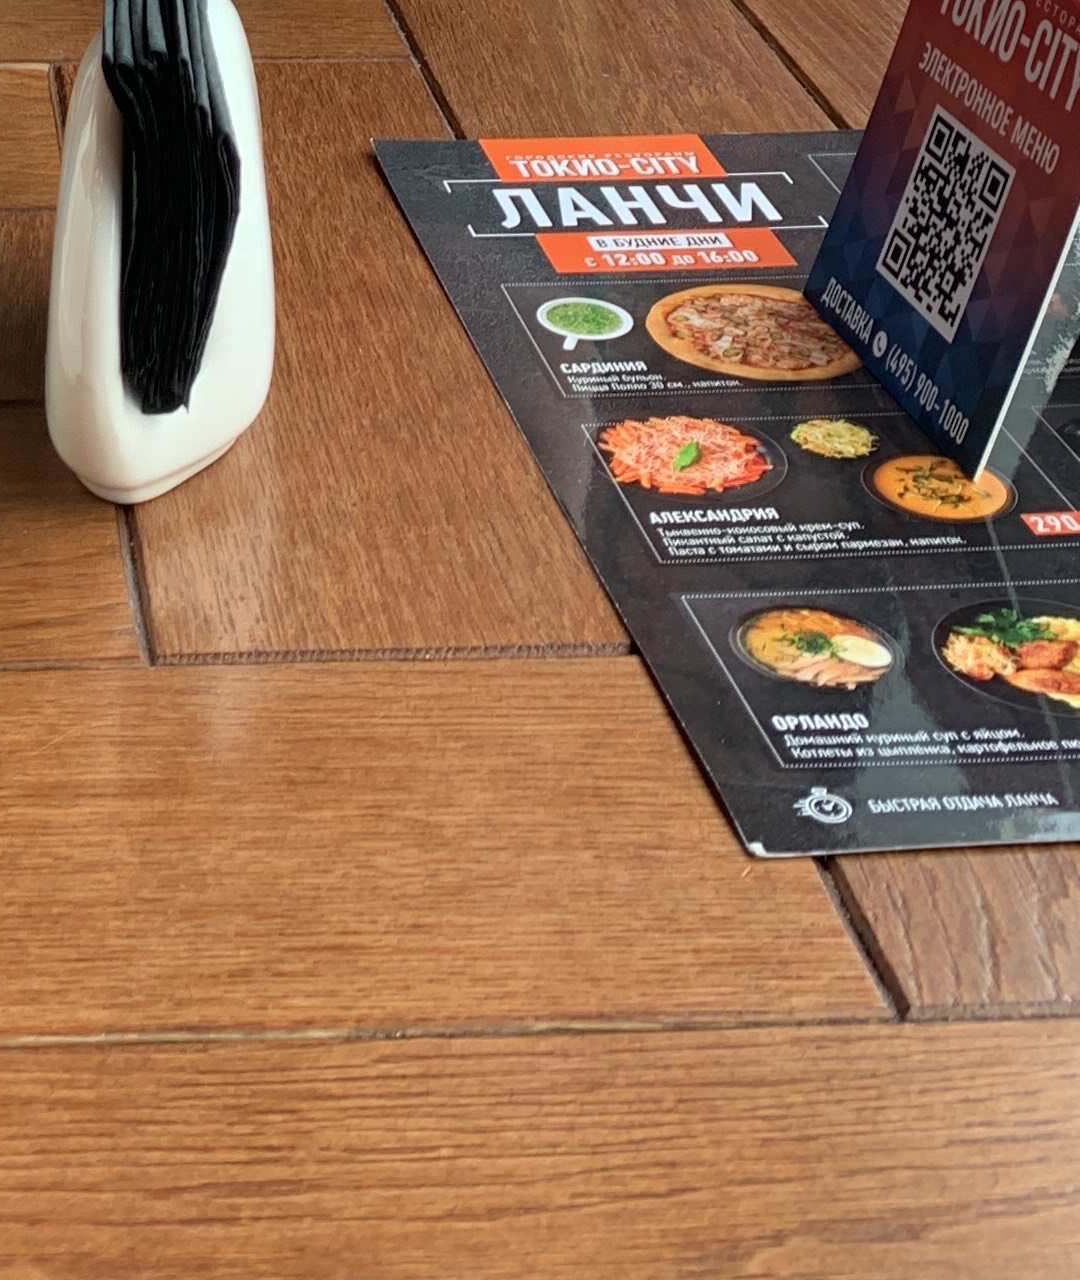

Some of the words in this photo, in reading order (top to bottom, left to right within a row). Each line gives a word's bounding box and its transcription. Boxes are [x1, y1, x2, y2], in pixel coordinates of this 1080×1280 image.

[918, 41, 1014, 137] ЭЛЕКТРОННОЕ
[1010, 115, 1060, 174] МЕНЮ
[509, 155, 700, 178] ТОКИО-CITY
[492, 182, 783, 229] ЛАНЧИ
[596, 236, 608, 248] В
[615, 235, 678, 249] БУДНИЕ
[684, 234, 722, 248] ДНИ
[603, 251, 666, 266] 12:00
[672, 254, 695, 266] до
[697, 250, 759, 265] 16:00
[560, 361, 648, 375] САРДИНИЯ
[821, 277, 874, 345] ДОСТАВКА
[885, 343, 917, 392] (495)
[913, 372, 969, 445] 900-1000
[567, 375, 620, 385] Куриный
[572, 383, 610, 392] Пицца
[648, 381, 665, 390] 30
[649, 507, 780, 524] АЛЕКСАНДРИЯ
[657, 523, 797, 538] Тыквенно-кокосовый
[663, 534, 736, 547] Пикантный
[738, 534, 773, 544] салат
[776, 534, 785, 543] с
[668, 546, 706, 557] Паста
[708, 546, 717, 554] с
[720, 544, 781, 554] томатами
[784, 544, 793, 552] и
[795, 542, 839, 553] сыром
[771, 713, 869, 731] ОРЛАНДО
[784, 732, 864, 747] Домашний
[866, 730, 930, 746] куриный
[933, 731, 958, 744] суп
[961, 730, 971, 740] с
[790, 747, 853, 759] Котлеты
[856, 747, 874, 757] из
[957, 740, 1059, 755] картофельное
[868, 797, 941, 814] БЫСТРАЯ
[942, 794, 1004, 811] ОТДАЧА
[1004, 792, 1059, 808] ЛАНЧА
